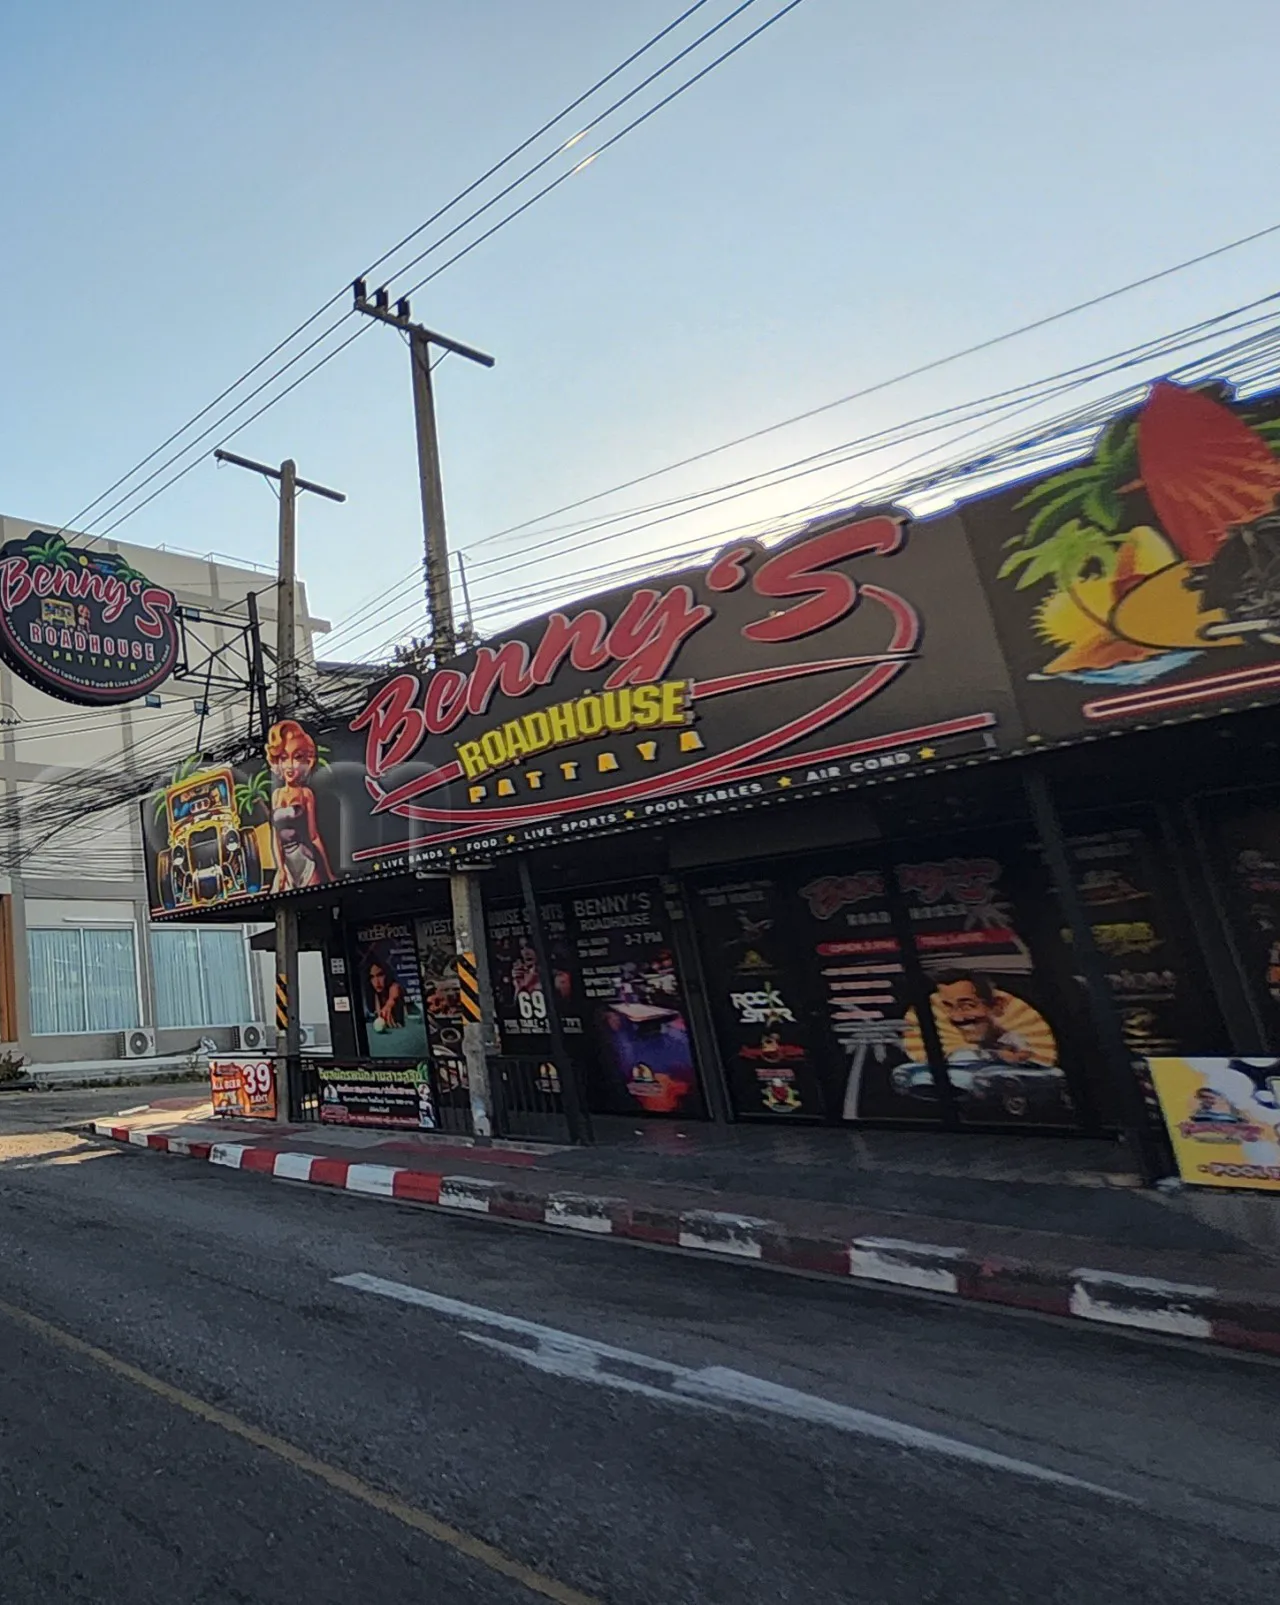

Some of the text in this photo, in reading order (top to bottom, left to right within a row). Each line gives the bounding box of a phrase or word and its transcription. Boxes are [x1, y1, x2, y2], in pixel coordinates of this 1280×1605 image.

[29, 622, 156, 662] ROADHOUSE
[53, 650, 137, 671] PATTAYA
[455, 680, 694, 780] ROADHOUSE
[469, 730, 706, 805] PATTAYA
[382, 753, 911, 870] LIVE BANDS FOOD LIVE SPORTS POOL TABLES AIR COND
[573, 892, 652, 917] BENNY'S
[580, 912, 651, 931] ROADHOUSE
[519, 990, 546, 1019] 69
[729, 989, 786, 1010] ROCK
[243, 1062, 271, 1095] 39
